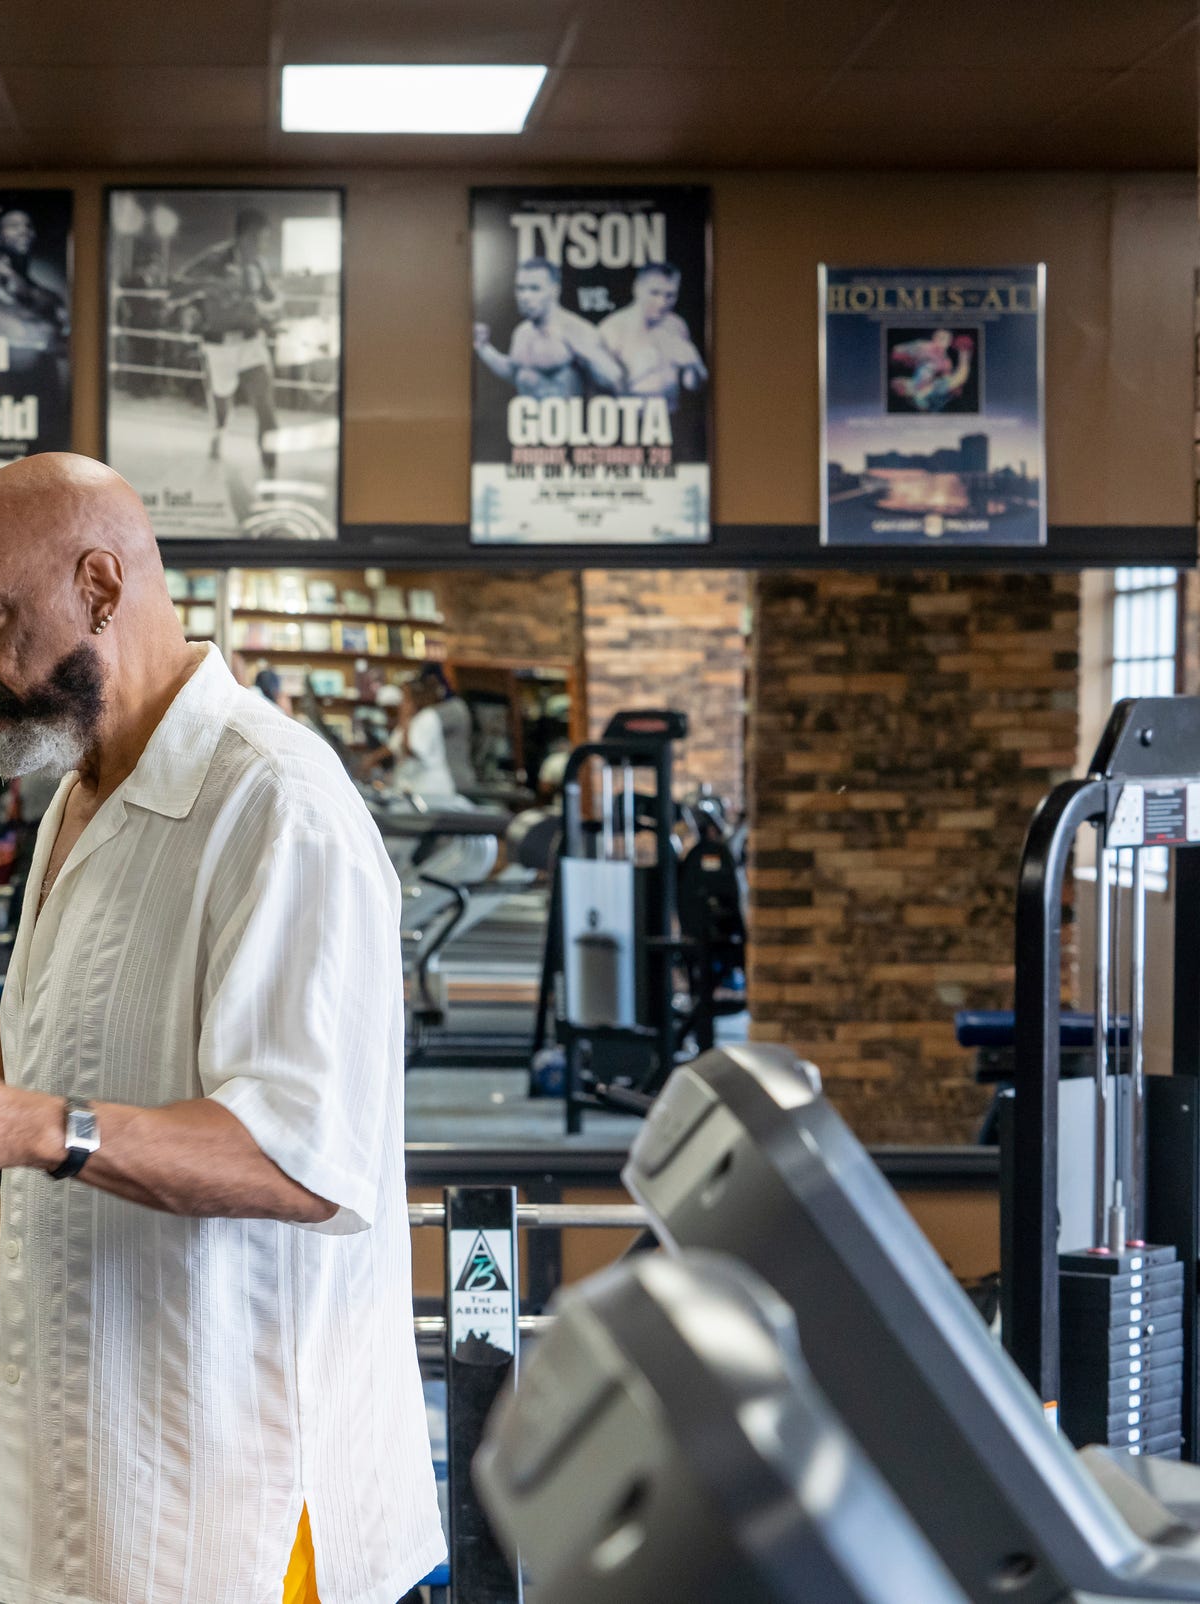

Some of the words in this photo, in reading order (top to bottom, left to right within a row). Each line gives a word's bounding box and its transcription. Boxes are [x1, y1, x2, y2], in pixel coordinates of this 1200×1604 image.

[510, 212, 666, 268] TYSON
[507, 395, 673, 447] GOLOTA
[456, 1306, 509, 1315] ABENCH
